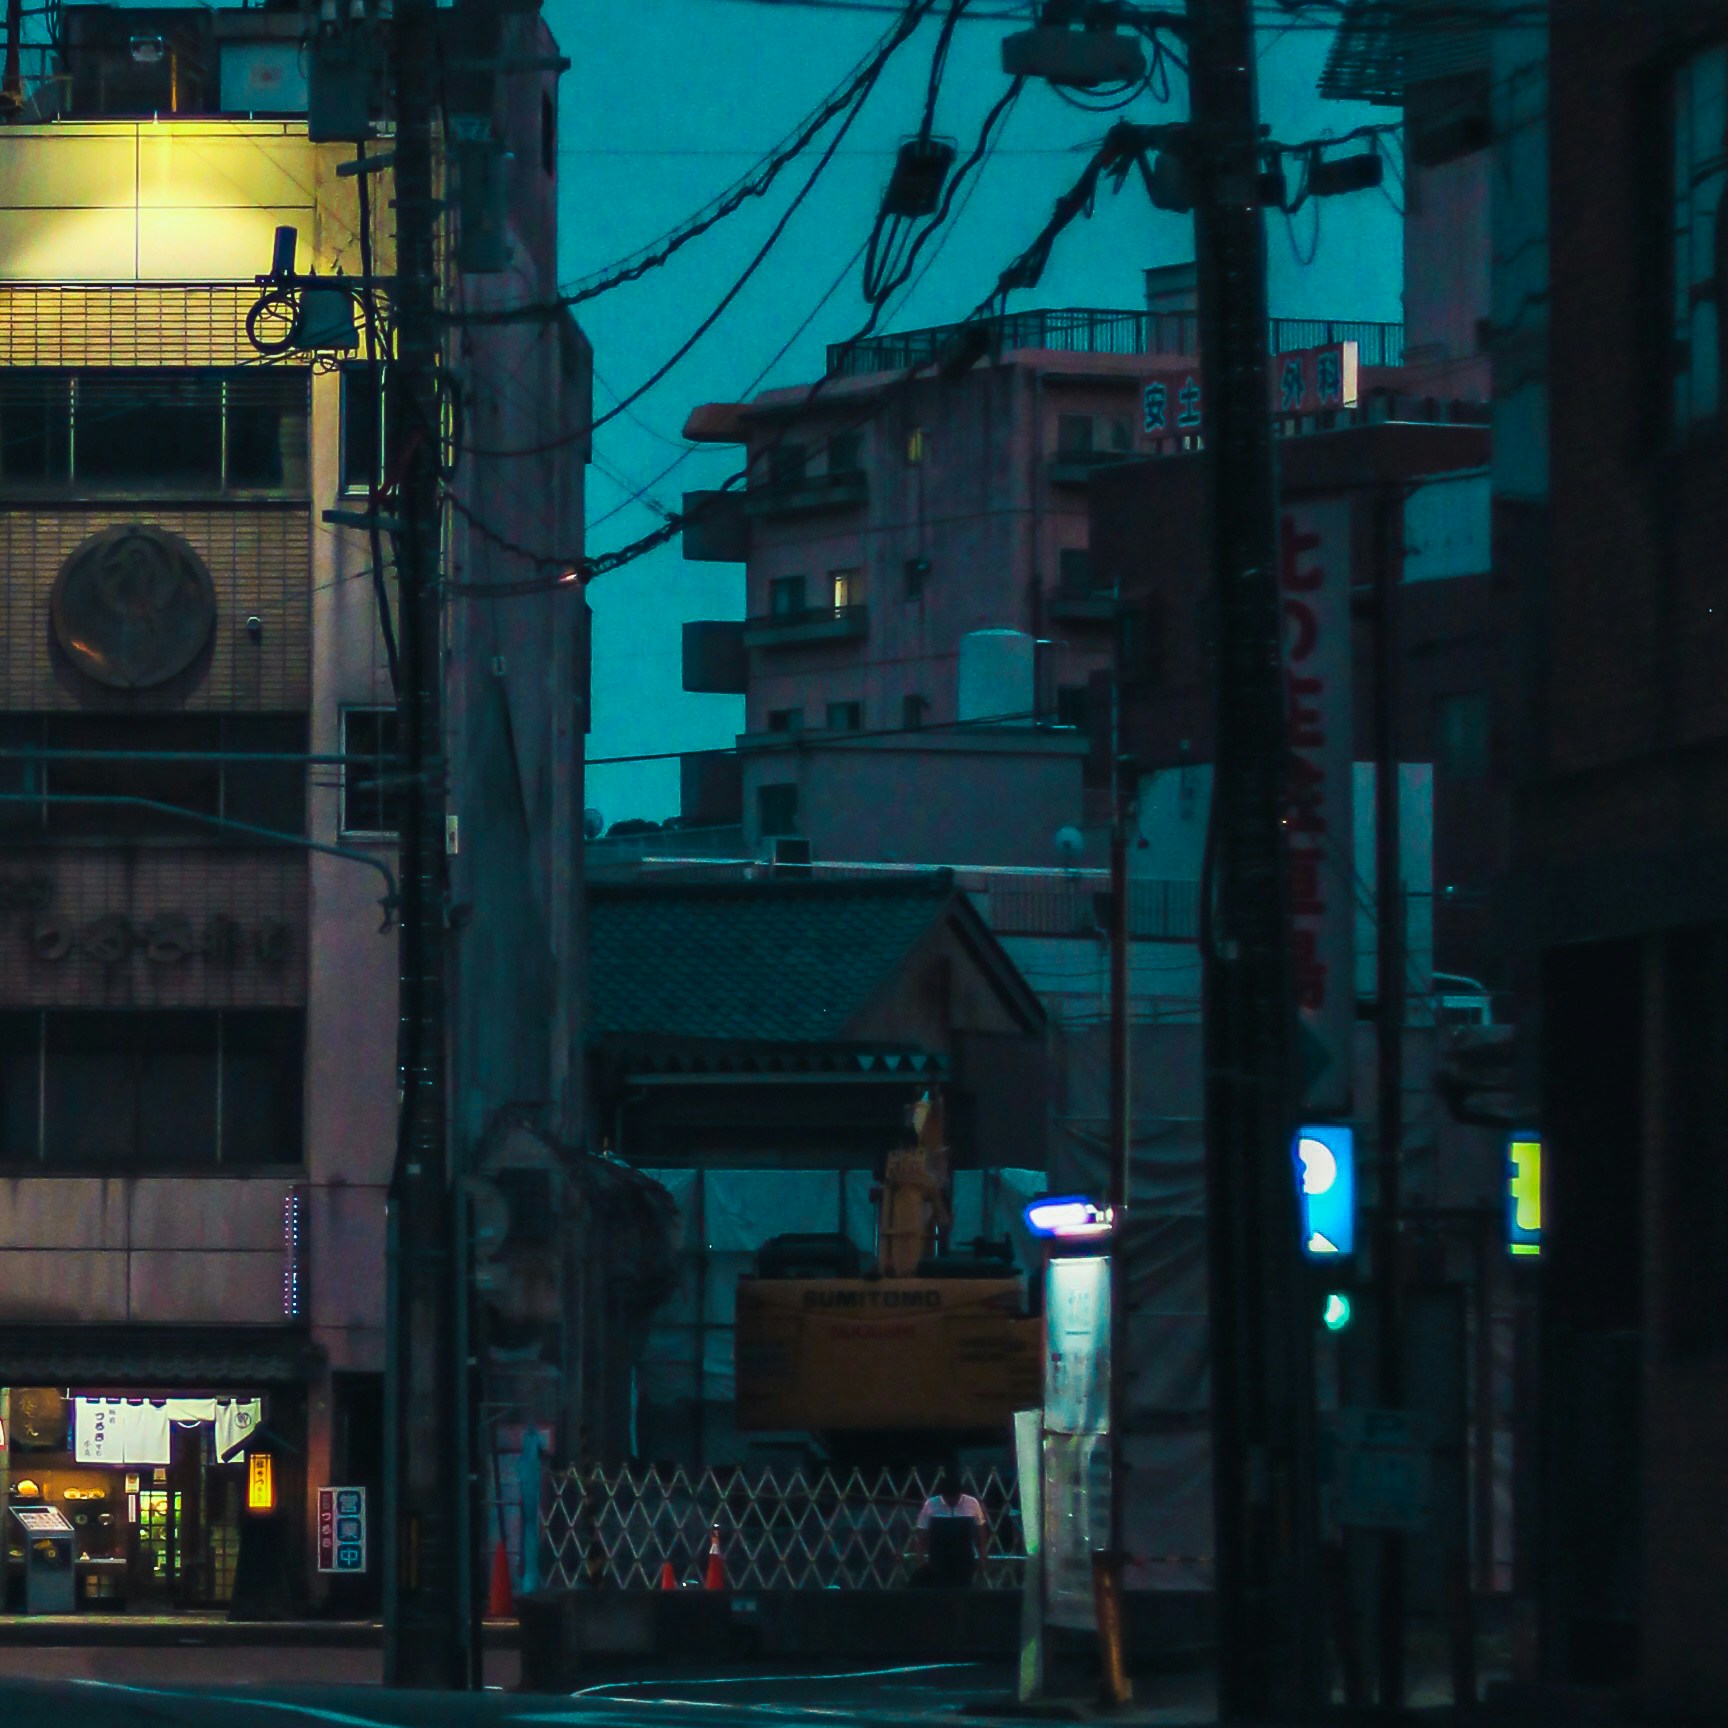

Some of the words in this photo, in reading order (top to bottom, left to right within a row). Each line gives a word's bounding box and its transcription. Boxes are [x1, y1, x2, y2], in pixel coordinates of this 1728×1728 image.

[1142, 349, 1341, 434] 安土外科
[803, 1289, 942, 1308] SUMITOMO
